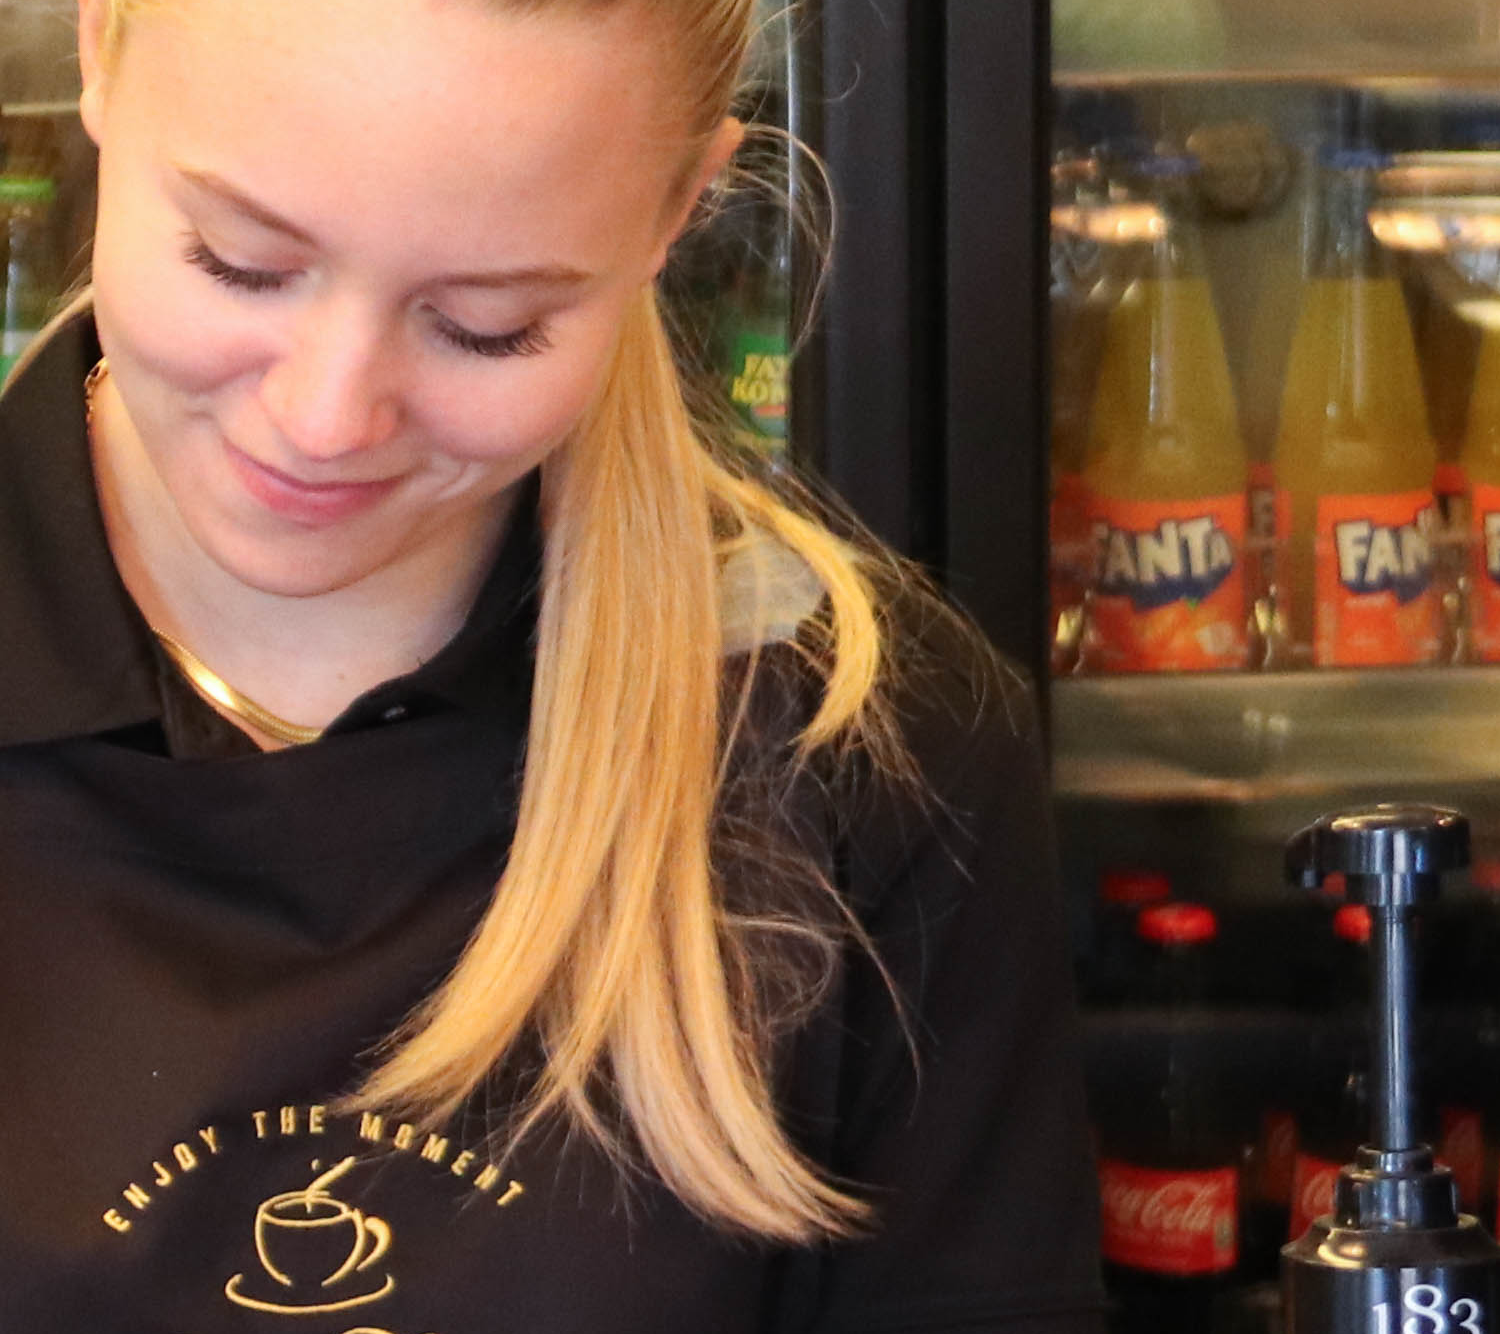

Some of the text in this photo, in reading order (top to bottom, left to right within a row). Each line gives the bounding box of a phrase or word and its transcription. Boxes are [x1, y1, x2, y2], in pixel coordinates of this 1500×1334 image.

[1336, 507, 1433, 584] FAN
[103, 1104, 525, 1235] ENJOY THE MOMENT
